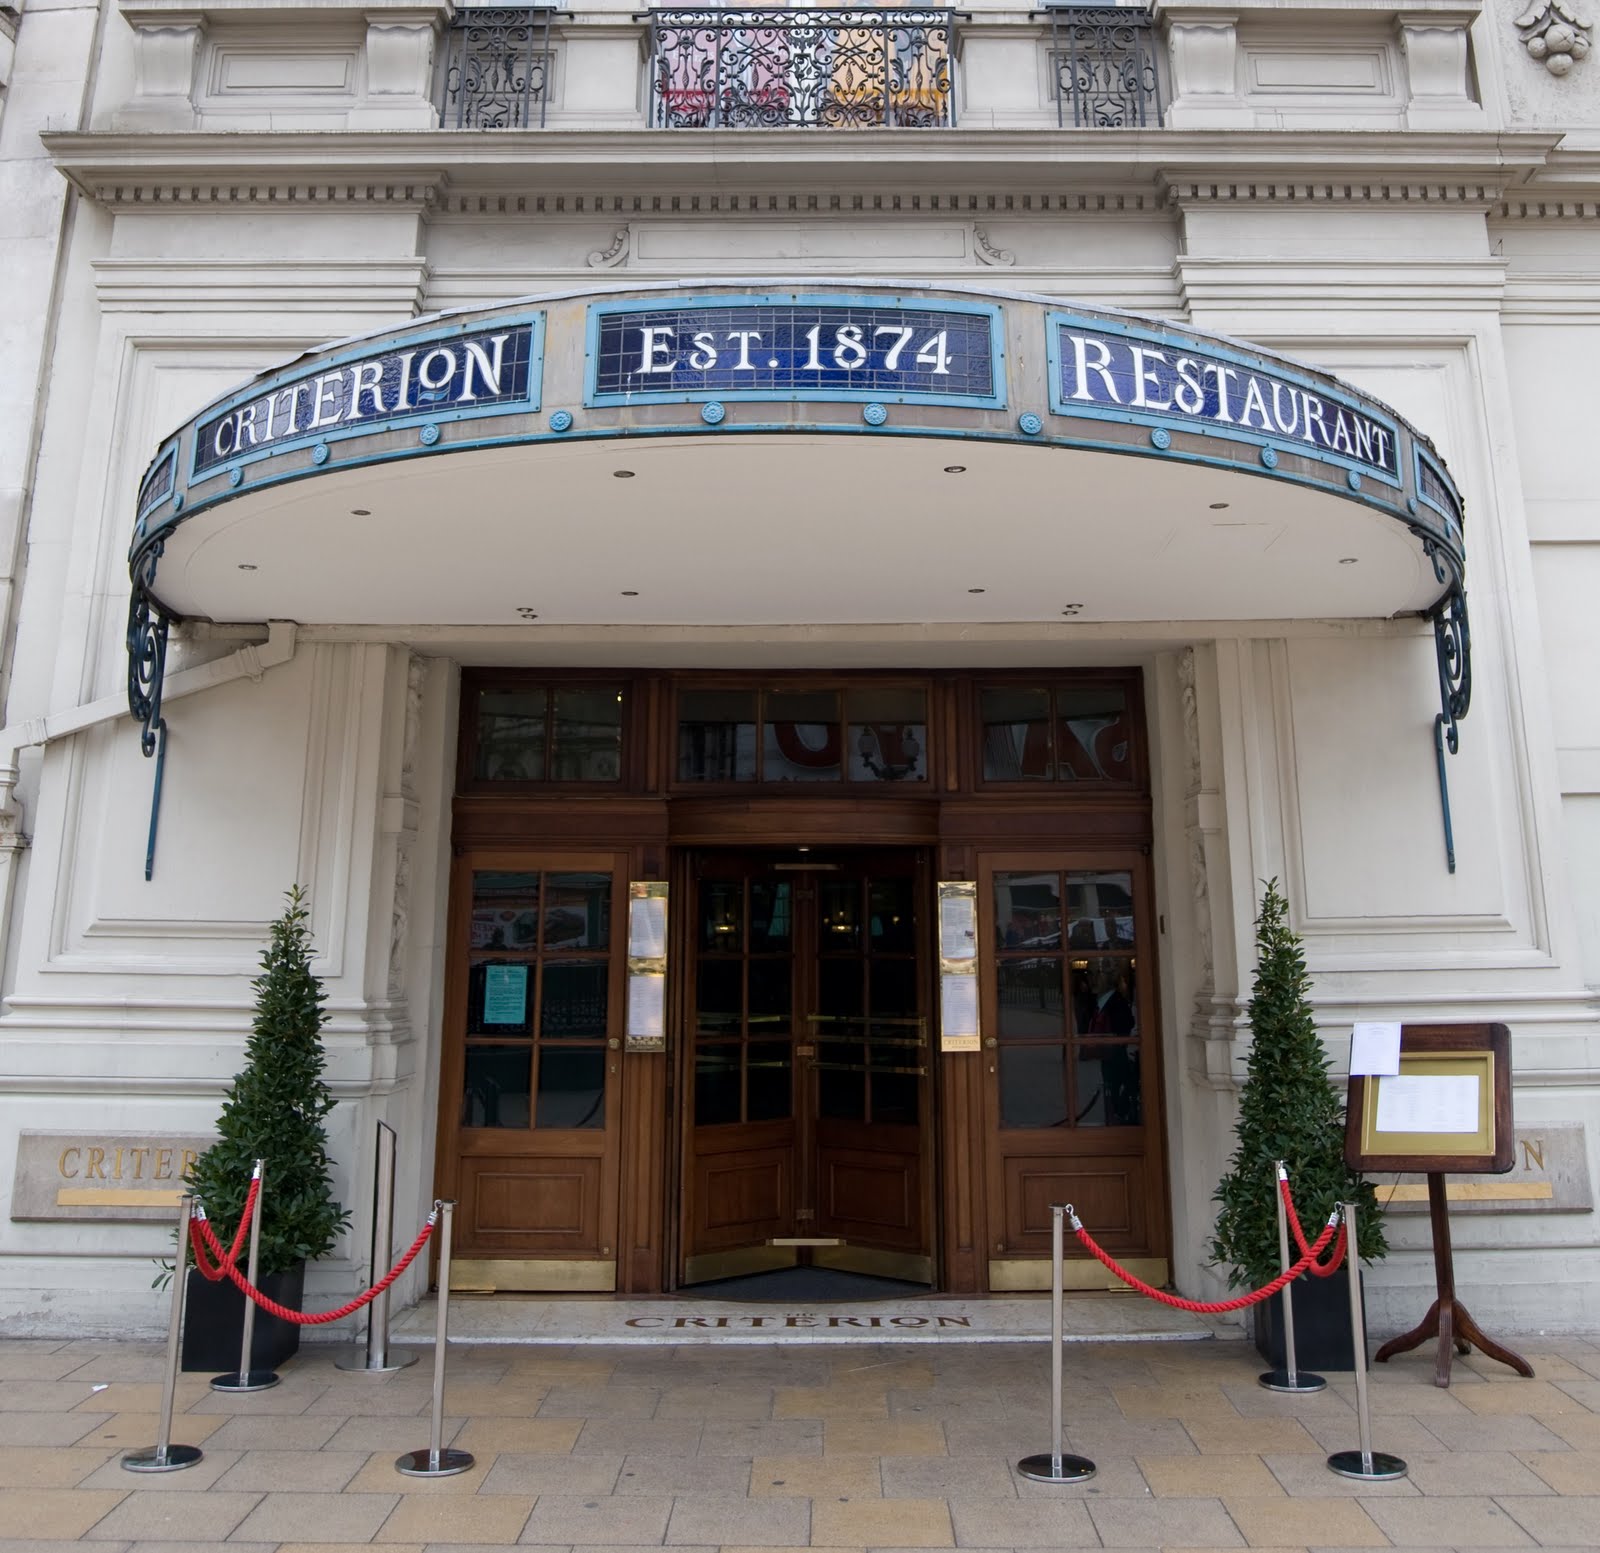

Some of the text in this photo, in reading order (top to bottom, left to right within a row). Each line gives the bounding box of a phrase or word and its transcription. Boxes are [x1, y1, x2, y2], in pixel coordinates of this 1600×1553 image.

[635, 324, 952, 375] EST. 1874
[214, 334, 509, 456] CRITERION
[1065, 335, 1389, 468] RESTAURANT
[58, 1147, 198, 1180] CRITER
[624, 1316, 972, 1328] CRITERION
